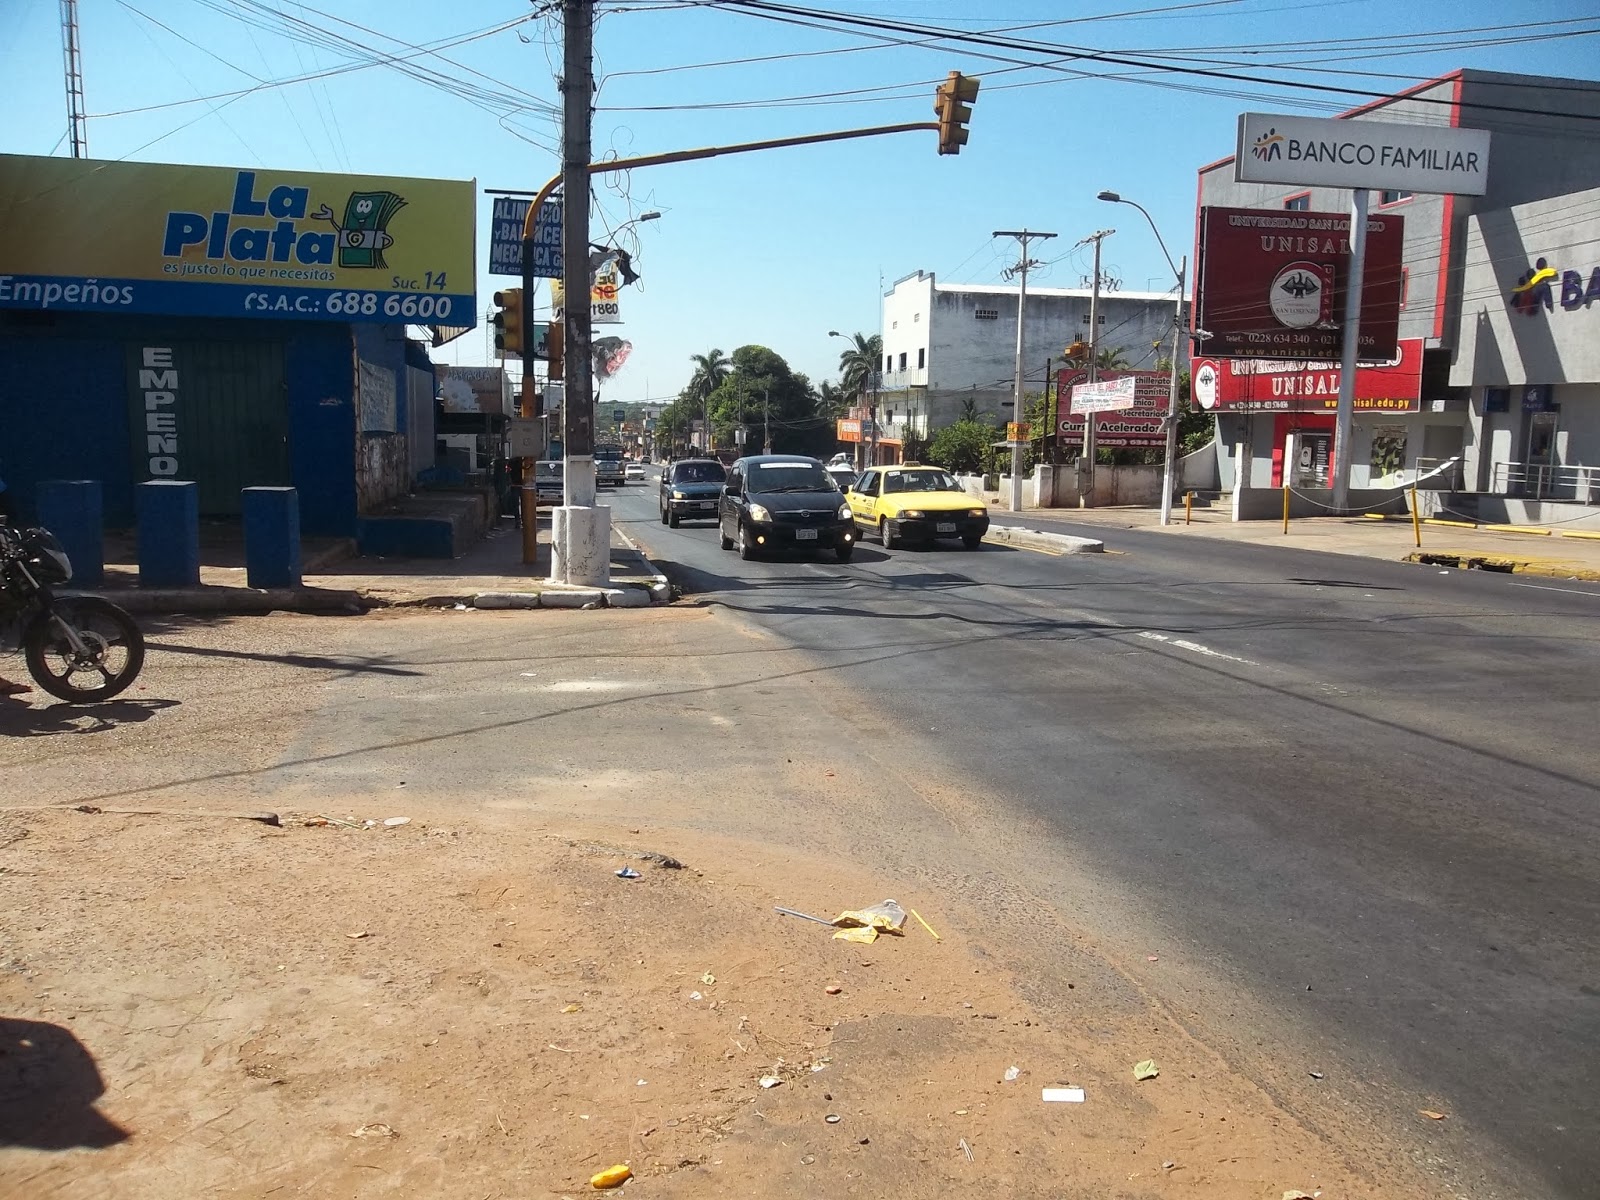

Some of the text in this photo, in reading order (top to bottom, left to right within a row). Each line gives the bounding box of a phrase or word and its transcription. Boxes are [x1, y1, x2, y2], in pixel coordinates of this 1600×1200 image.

[1288, 139, 1479, 173] BANCO FAMILIAR
[232, 171, 310, 219] La
[494, 201, 563, 224] ALINCIO
[1228, 215, 1385, 232] UNIVERSIDAD SAN LOZO
[162, 211, 337, 265] Plata
[501, 222, 563, 245] BALNCE
[1261, 235, 1352, 255] UNISAL
[163, 263, 336, 281] es justo lo que necesitás
[392, 271, 447, 290] Suc. 14
[0, 275, 134, 309] Empeños
[256, 292, 452, 319] S.A.C.: 688 6600
[1248, 333, 1271, 343] 0228
[1273, 334, 1290, 343] 634
[1293, 334, 1310, 344] 340
[1320, 335, 1336, 345] 021
[1271, 374, 1340, 396] UNISAL
[139, 347, 178, 475] EMPEÑO
